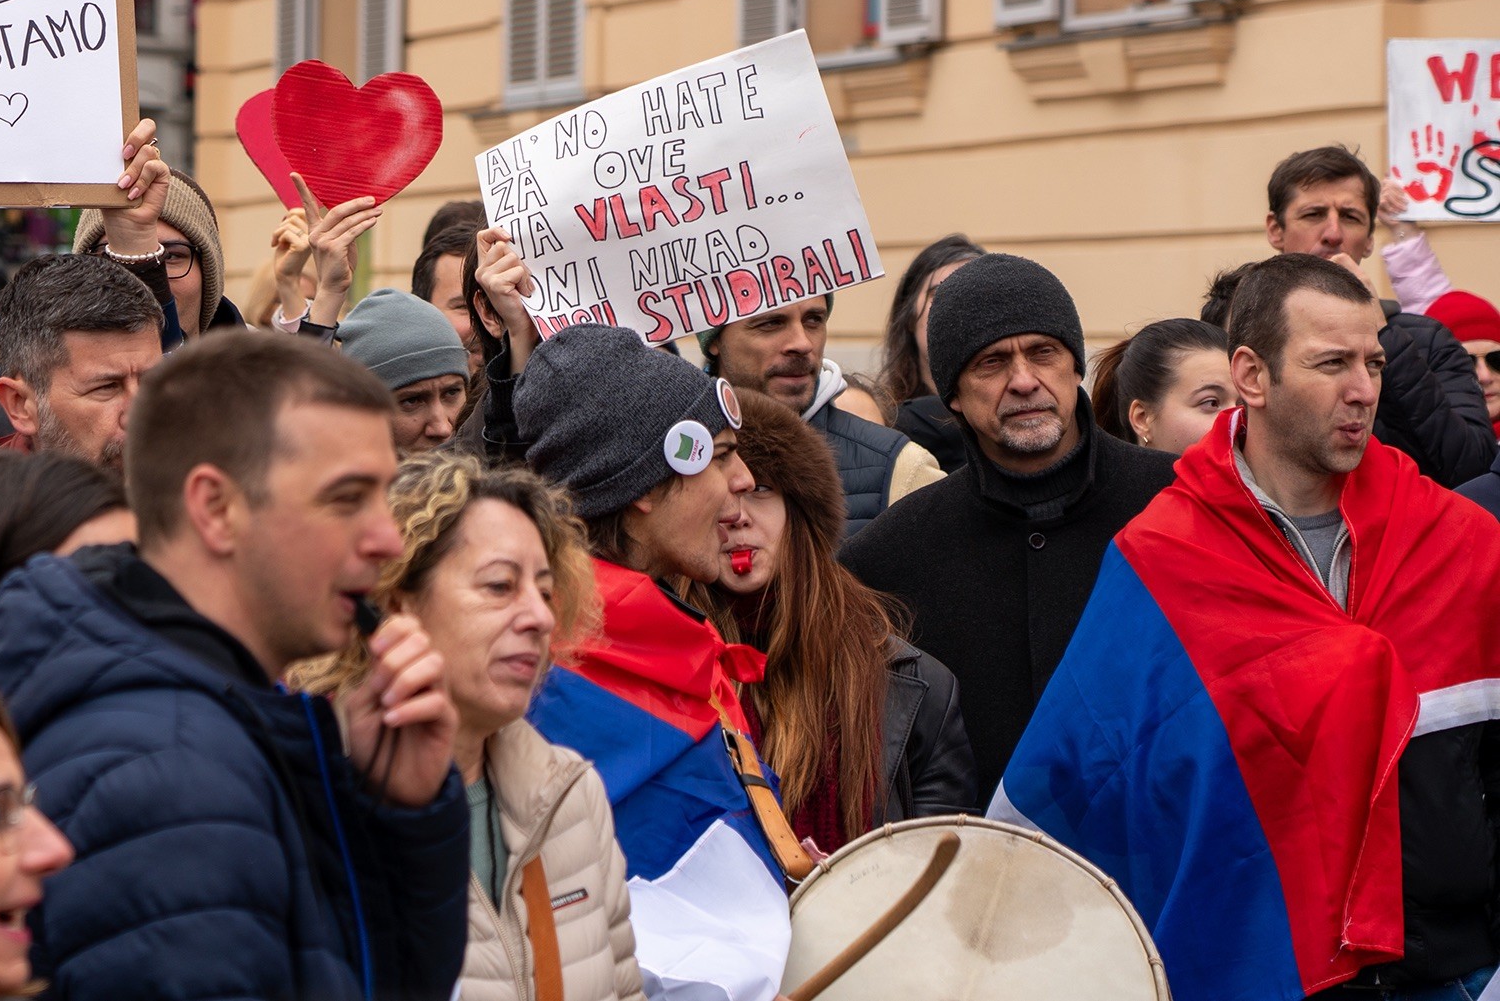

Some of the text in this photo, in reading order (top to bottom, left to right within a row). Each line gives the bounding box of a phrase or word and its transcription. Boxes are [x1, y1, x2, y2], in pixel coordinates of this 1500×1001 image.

[555, 110, 607, 160] NO
[641, 64, 765, 136] HATE
[491, 139, 686, 222] ZA OVE
[629, 225, 770, 291] NIKAD
[637, 229, 872, 342] STUDIRALI
